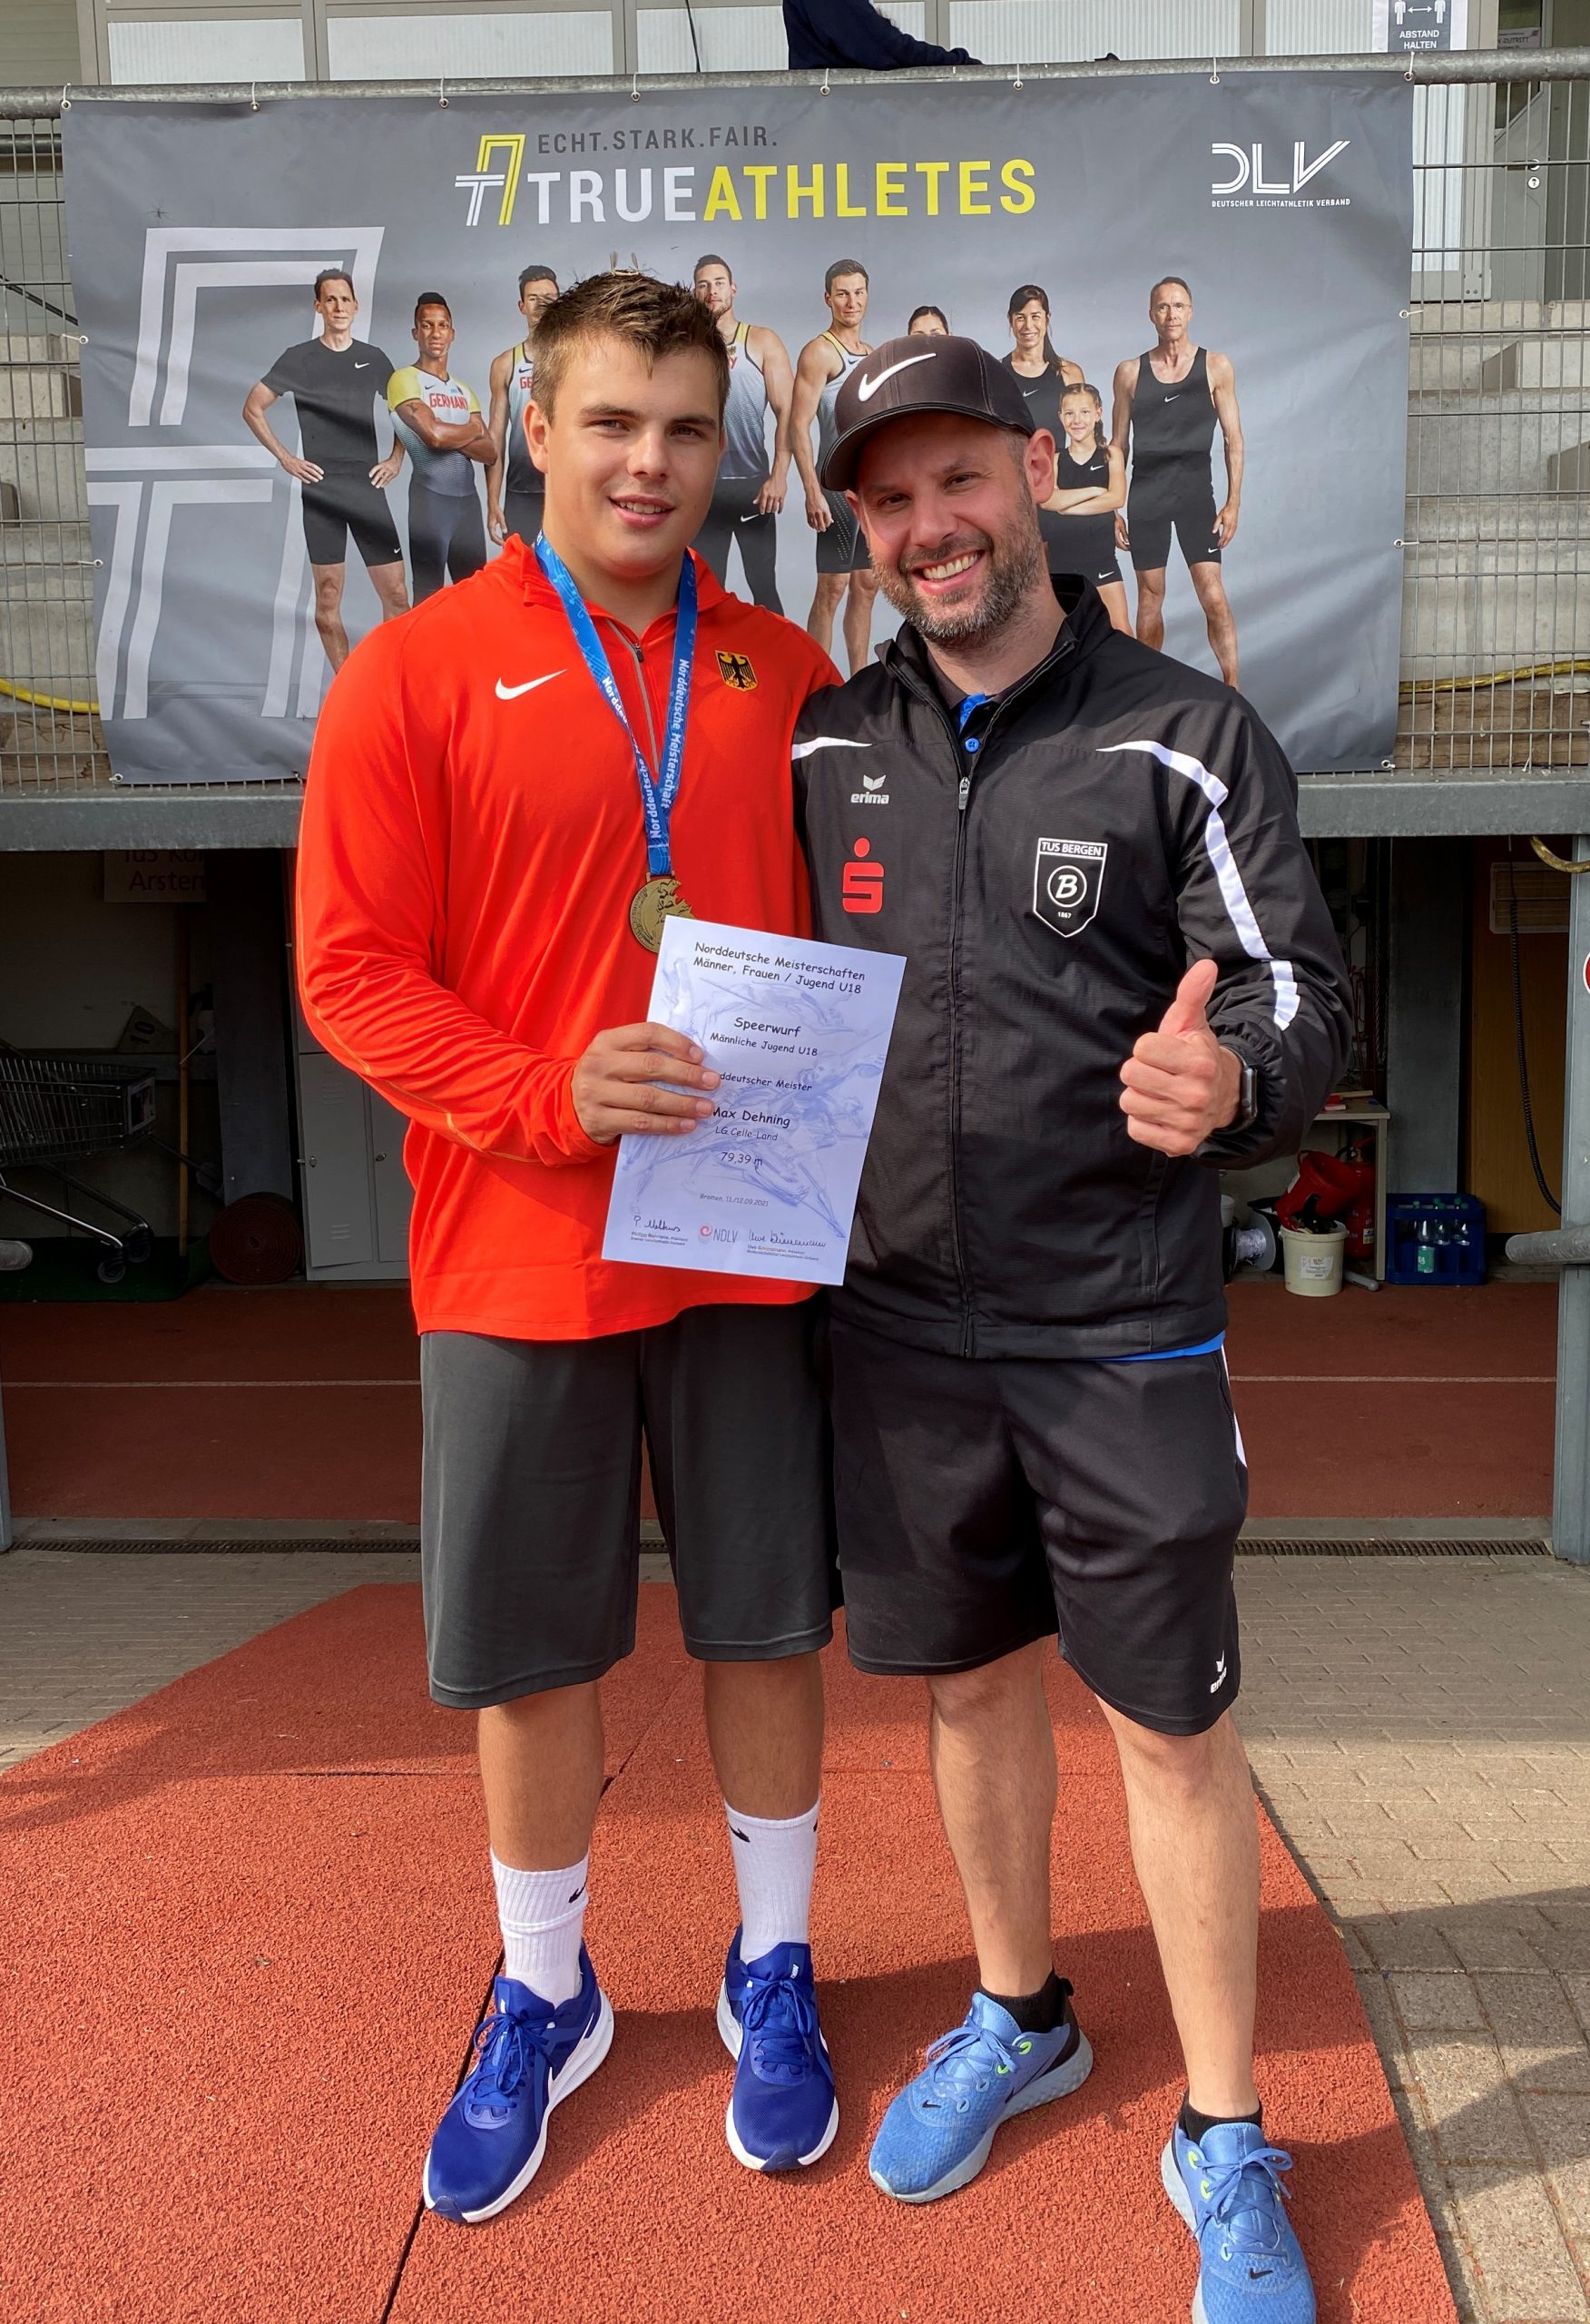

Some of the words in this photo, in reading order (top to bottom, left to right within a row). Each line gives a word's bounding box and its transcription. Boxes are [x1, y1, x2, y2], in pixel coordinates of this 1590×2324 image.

[1399, 29, 1440, 39] ABSTAND
[1403, 41, 1437, 50] HALTEN
[1212, 140, 1351, 194] DLV
[1212, 199, 1254, 208] DEUTSCHER
[1256, 199, 1314, 208] LEICHTATHLETIK
[1316, 198, 1351, 207] VERBAND
[672, 658, 691, 729] Norddeutsche
[850, 791, 890, 804] erima
[1041, 841, 1061, 852] TUS
[1062, 843, 1102, 856] BERGEN
[129, 871, 205, 891] Arsten
[1055, 874, 1078, 899] B
[694, 941, 770, 964] Norddeutsche
[774, 956, 866, 981] Meisterschaften
[692, 956, 736, 975] Männer,
[742, 965, 780, 981] Frauen
[784, 972, 792, 982] /
[795, 974, 836, 990] Jugend
[839, 982, 862, 994] U18
[733, 1017, 801, 1038] Speerwurf
[710, 1032, 757, 1048] Männliche
[761, 1040, 795, 1053] Jugend
[798, 1046, 819, 1057] U18
[720, 1071, 772, 1087] ddeutscher
[775, 1079, 812, 1092] Meister
[741, 1109, 791, 1129] Dehning
[715, 1126, 729, 1135] LG
[720, 1151, 752, 1165] 79,39
[712, 1228, 739, 1244] NDLV
